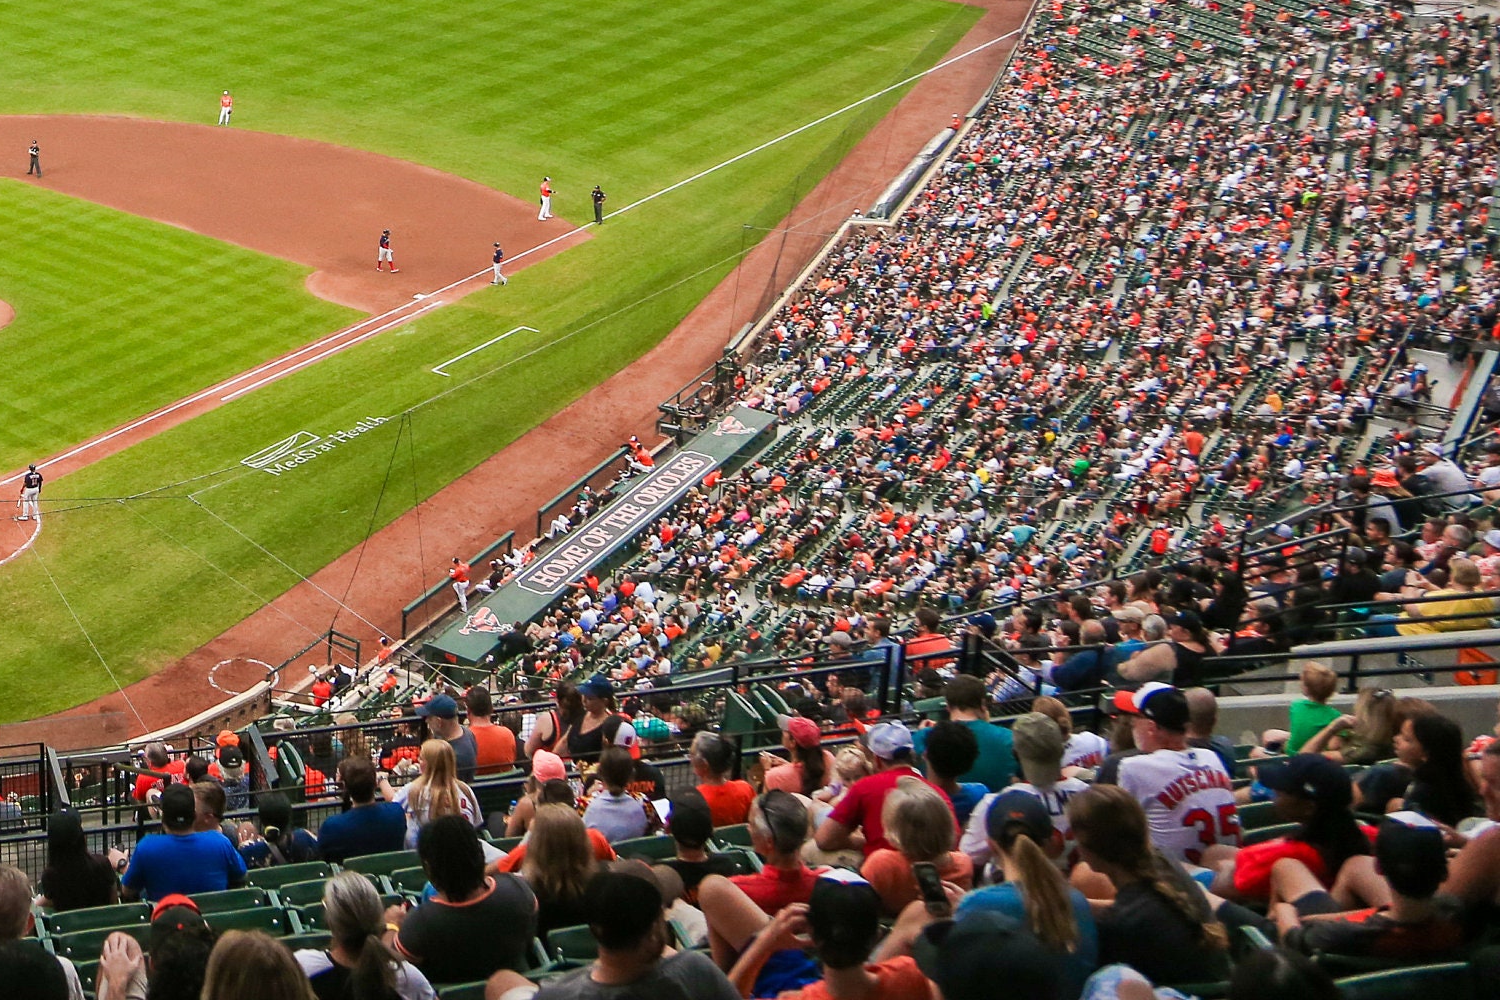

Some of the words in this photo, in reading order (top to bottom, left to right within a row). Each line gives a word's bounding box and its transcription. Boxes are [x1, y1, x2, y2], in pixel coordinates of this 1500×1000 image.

[263, 439, 337, 477] MedStar
[329, 416, 389, 443] Health
[527, 542, 589, 588] HOME
[580, 525, 611, 550] OF
[605, 502, 643, 534] THE
[636, 456, 706, 507] ORIOLES
[1184, 802, 1244, 866] 35
